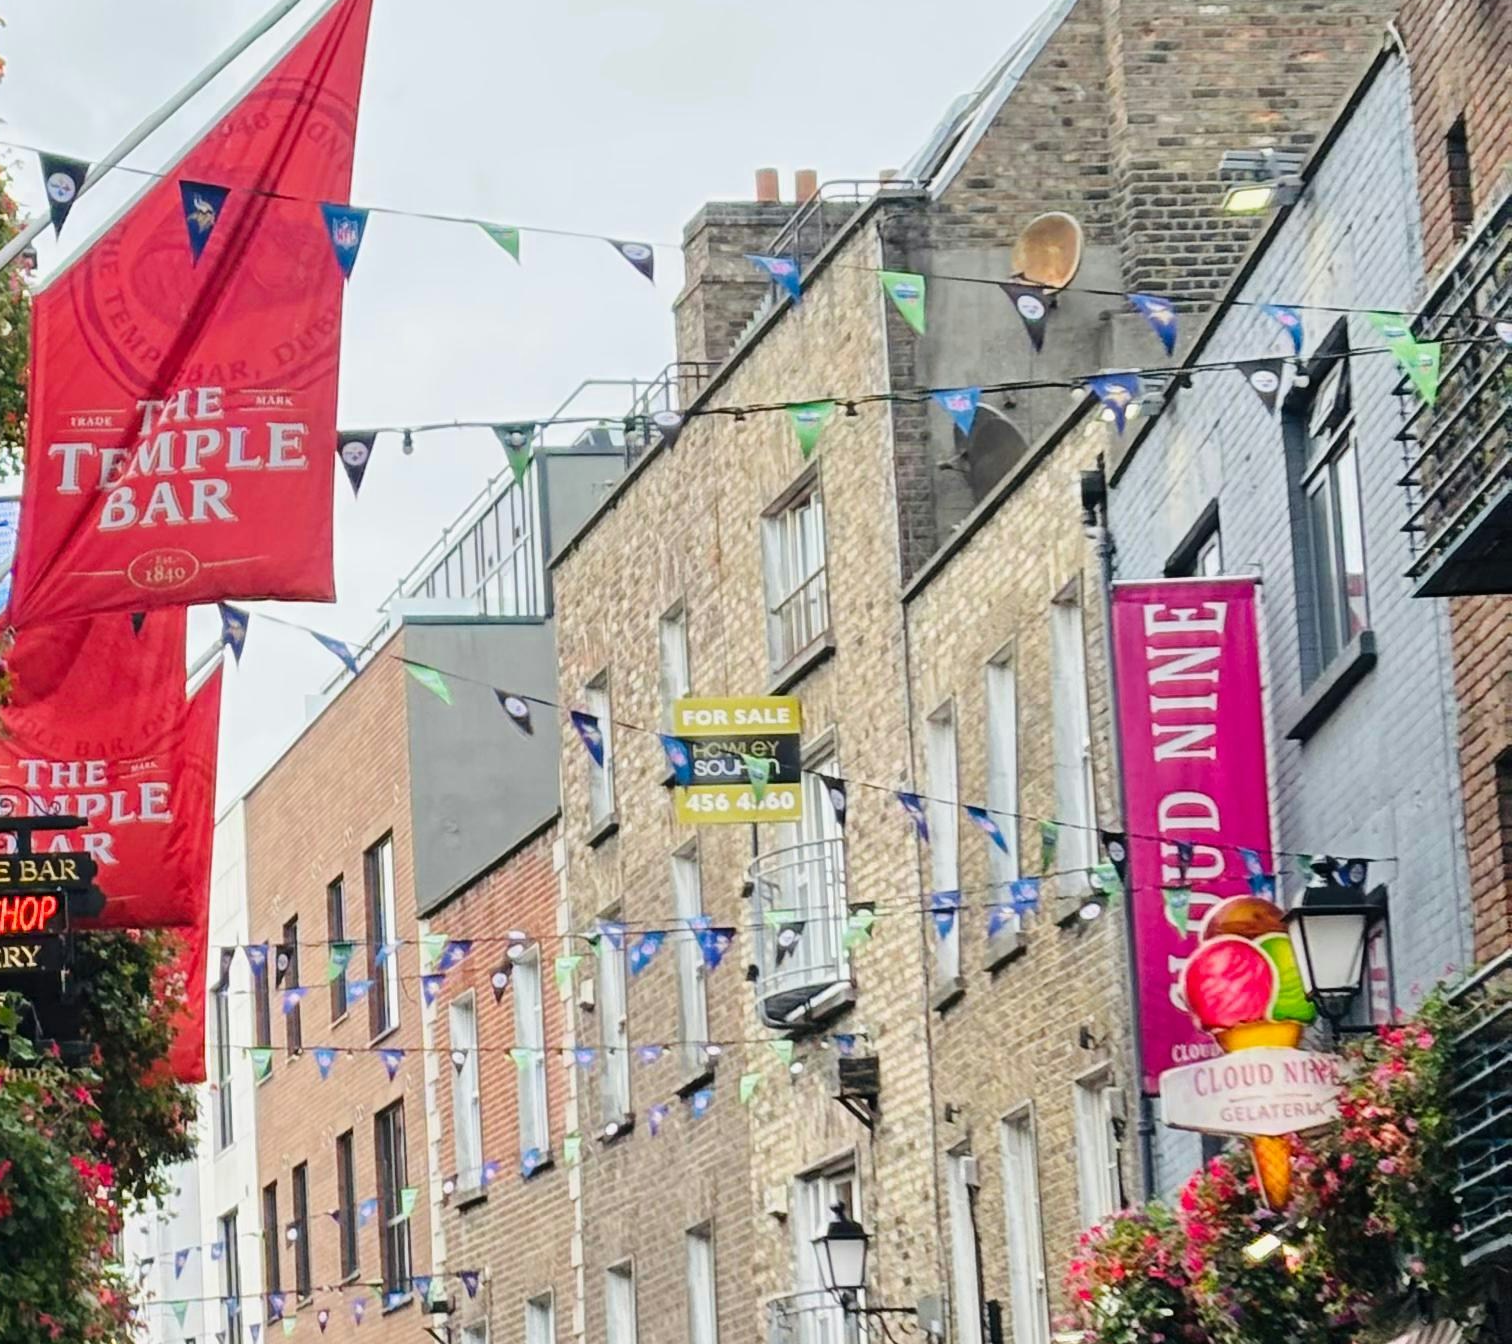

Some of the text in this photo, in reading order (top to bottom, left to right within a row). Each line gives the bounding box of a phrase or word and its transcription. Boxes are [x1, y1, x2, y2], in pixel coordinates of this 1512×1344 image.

[136, 386, 226, 438] THE
[255, 394, 294, 407] MARK
[70, 415, 114, 428] TRADE
[48, 422, 310, 495] TEMPLE
[95, 477, 240, 533] BAR
[144, 562, 187, 584] 1840
[1143, 600, 1228, 763] NINE
[681, 707, 791, 727] FOR SALE
[18, 758, 109, 789] THE
[685, 793, 731, 813] 456
[19, 858, 80, 883] BAR
[1193, 1063, 1274, 1097] CLOUD
